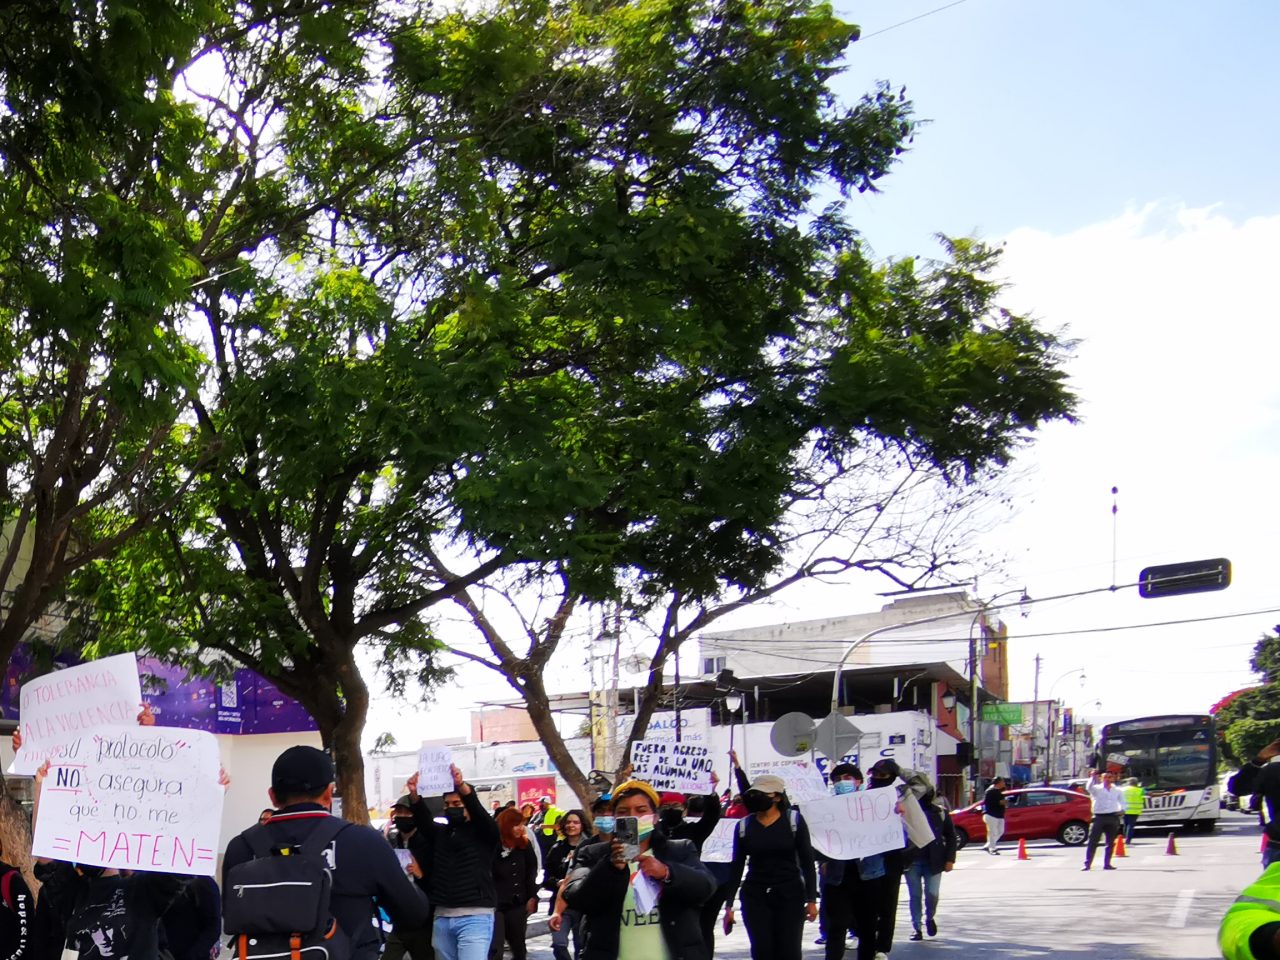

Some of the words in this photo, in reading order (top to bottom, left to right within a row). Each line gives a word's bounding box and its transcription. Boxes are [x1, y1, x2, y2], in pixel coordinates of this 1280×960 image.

[636, 743, 666, 754] FUERA
[634, 753, 650, 763] RES
[659, 756, 668, 765] DE
[676, 757, 687, 767] LA
[692, 758, 713, 773] UAQ
[653, 765, 698, 781] ALUMNAS
[56, 767, 81, 788] NO
[98, 773, 183, 799] asegura
[69, 804, 100, 822] que
[114, 803, 138, 822] no
[148, 809, 180, 825] me
